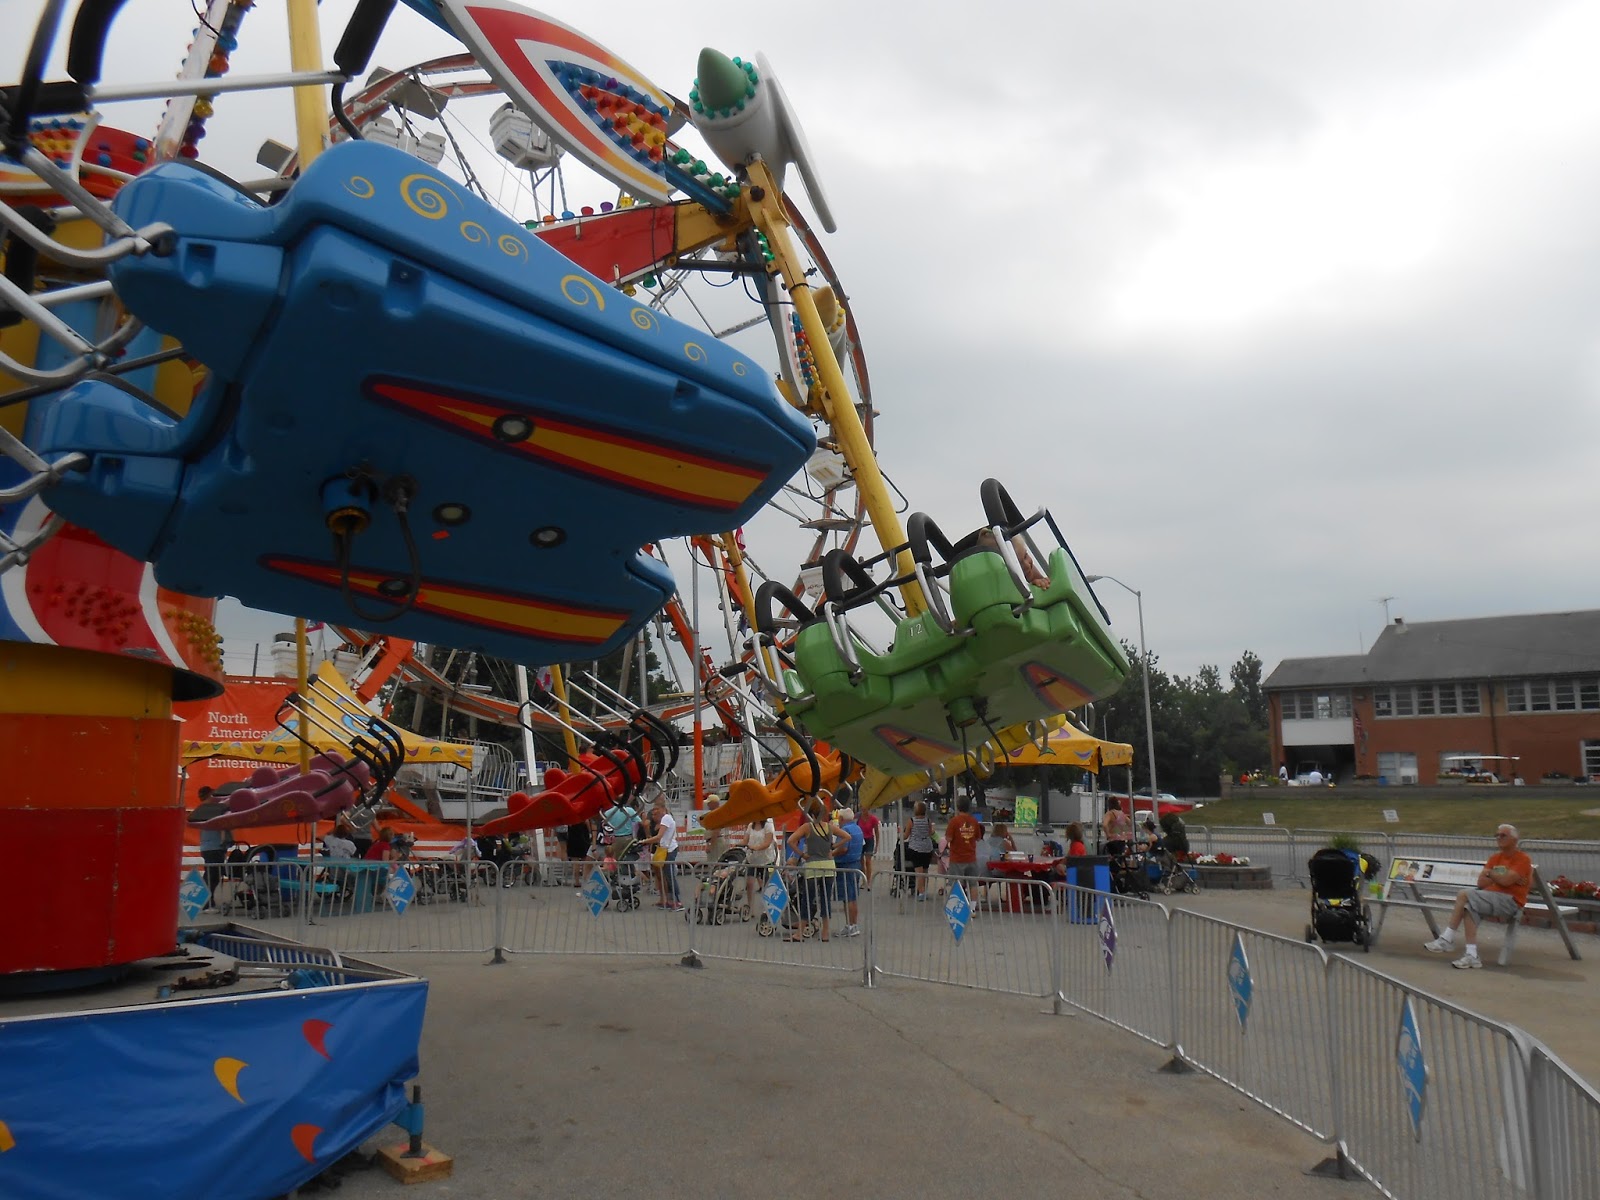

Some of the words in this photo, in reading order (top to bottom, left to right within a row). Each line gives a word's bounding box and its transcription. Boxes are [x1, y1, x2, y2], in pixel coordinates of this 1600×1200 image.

[910, 623, 923, 637] 12
[207, 711, 248, 724] North
[208, 726, 272, 740] America
